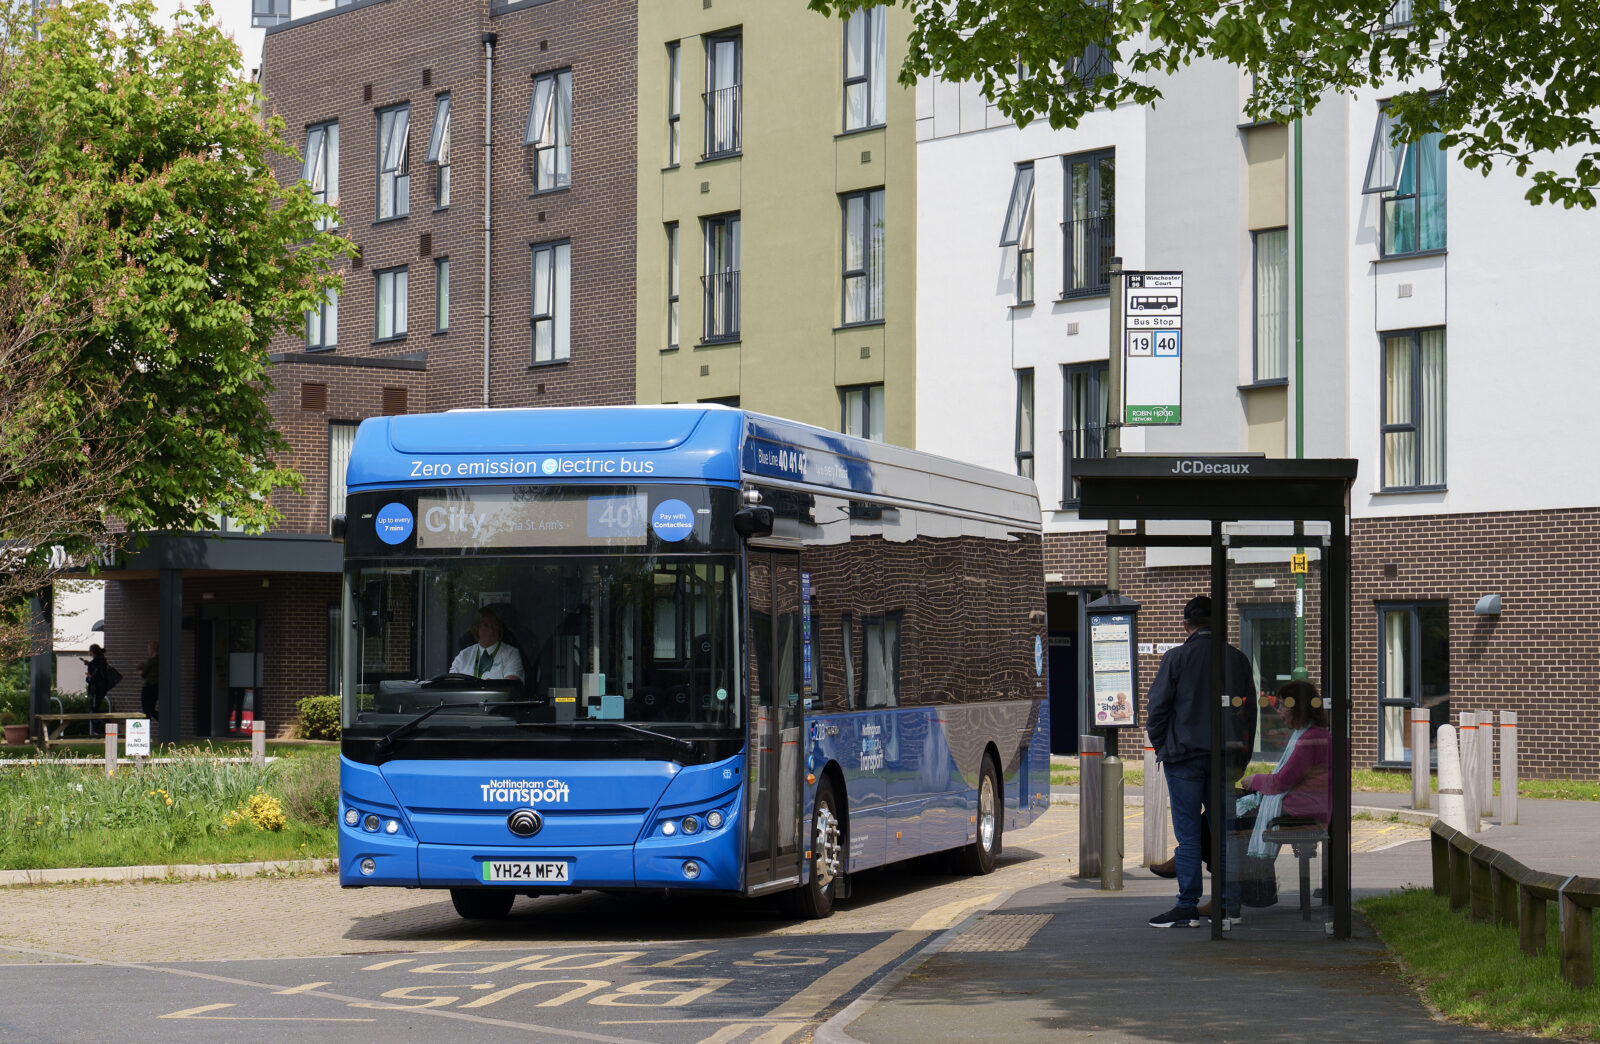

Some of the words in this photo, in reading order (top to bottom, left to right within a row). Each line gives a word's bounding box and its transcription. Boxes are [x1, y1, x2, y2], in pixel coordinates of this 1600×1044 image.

[1133, 317, 1151, 326] Bus
[1153, 317, 1174, 328] Stop
[1132, 337, 1150, 351] 19
[1157, 337, 1176, 351] 40
[1153, 409, 1174, 418] HOOD
[410, 461, 452, 477] Zero
[457, 459, 537, 475] emission
[541, 457, 616, 475] electric
[620, 457, 654, 474] bus
[758, 448, 768, 466] Blue
[768, 451, 778, 467] Line
[778, 449, 788, 472] 40
[789, 451, 798, 473] 41
[798, 453, 808, 475] 42
[1171, 460, 1250, 475] JCDecaux
[378, 518, 387, 526] Up
[394, 518, 411, 526] every
[425, 505, 487, 539] City
[525, 519, 536, 531] St.
[539, 519, 564, 532] Ann's
[599, 500, 633, 528] 40
[653, 521, 692, 529] Contactless
[1102, 703, 1126, 712] shops
[859, 746, 884, 775] Transport
[489, 779, 545, 791] Nottingham
[546, 778, 567, 792] City
[480, 784, 570, 806] Transport
[492, 863, 532, 880] YH24
[535, 863, 565, 880] MFX
[409, 947, 846, 975] STOP
[347, 977, 734, 1008] BUS
